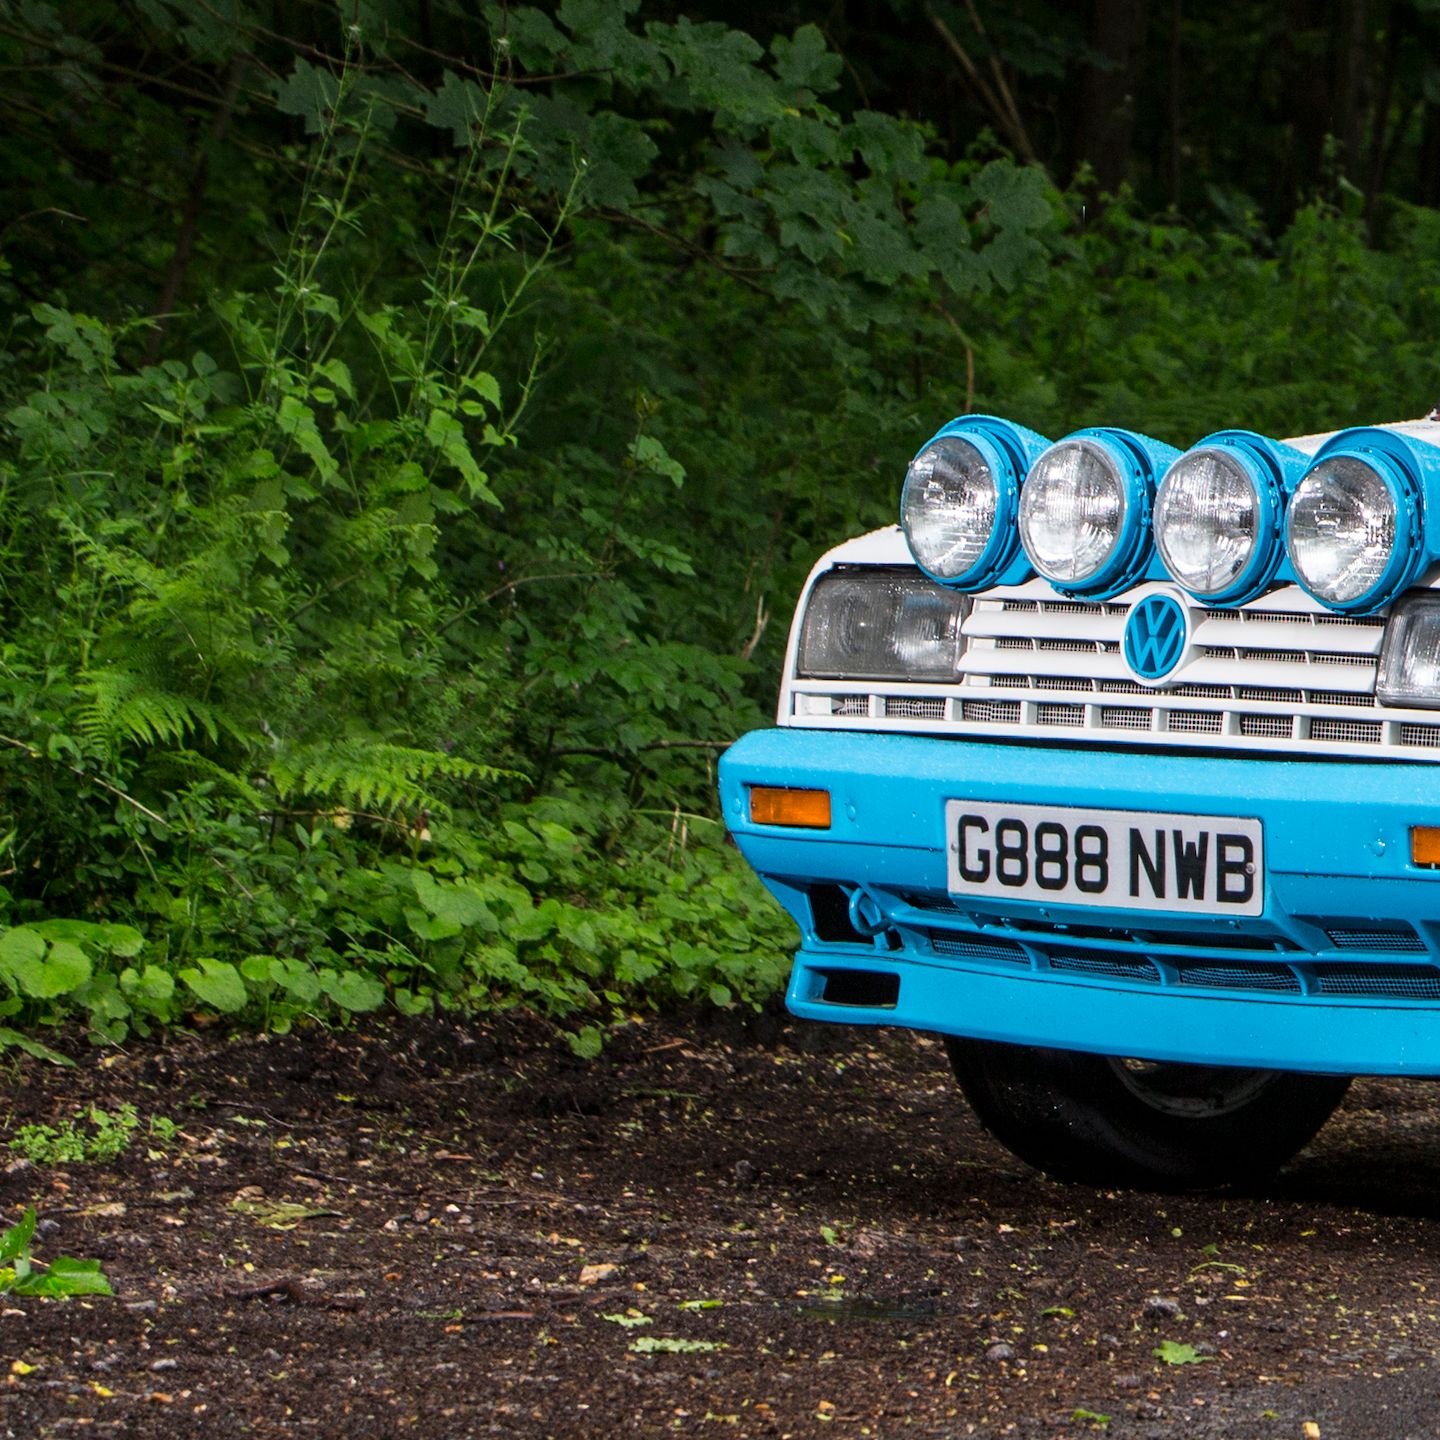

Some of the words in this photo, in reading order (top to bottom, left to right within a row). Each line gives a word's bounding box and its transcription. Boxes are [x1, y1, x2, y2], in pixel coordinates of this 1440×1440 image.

[1125, 594, 1186, 679] VW
[958, 814, 1109, 893] G888
[1129, 827, 1254, 904] NWB
